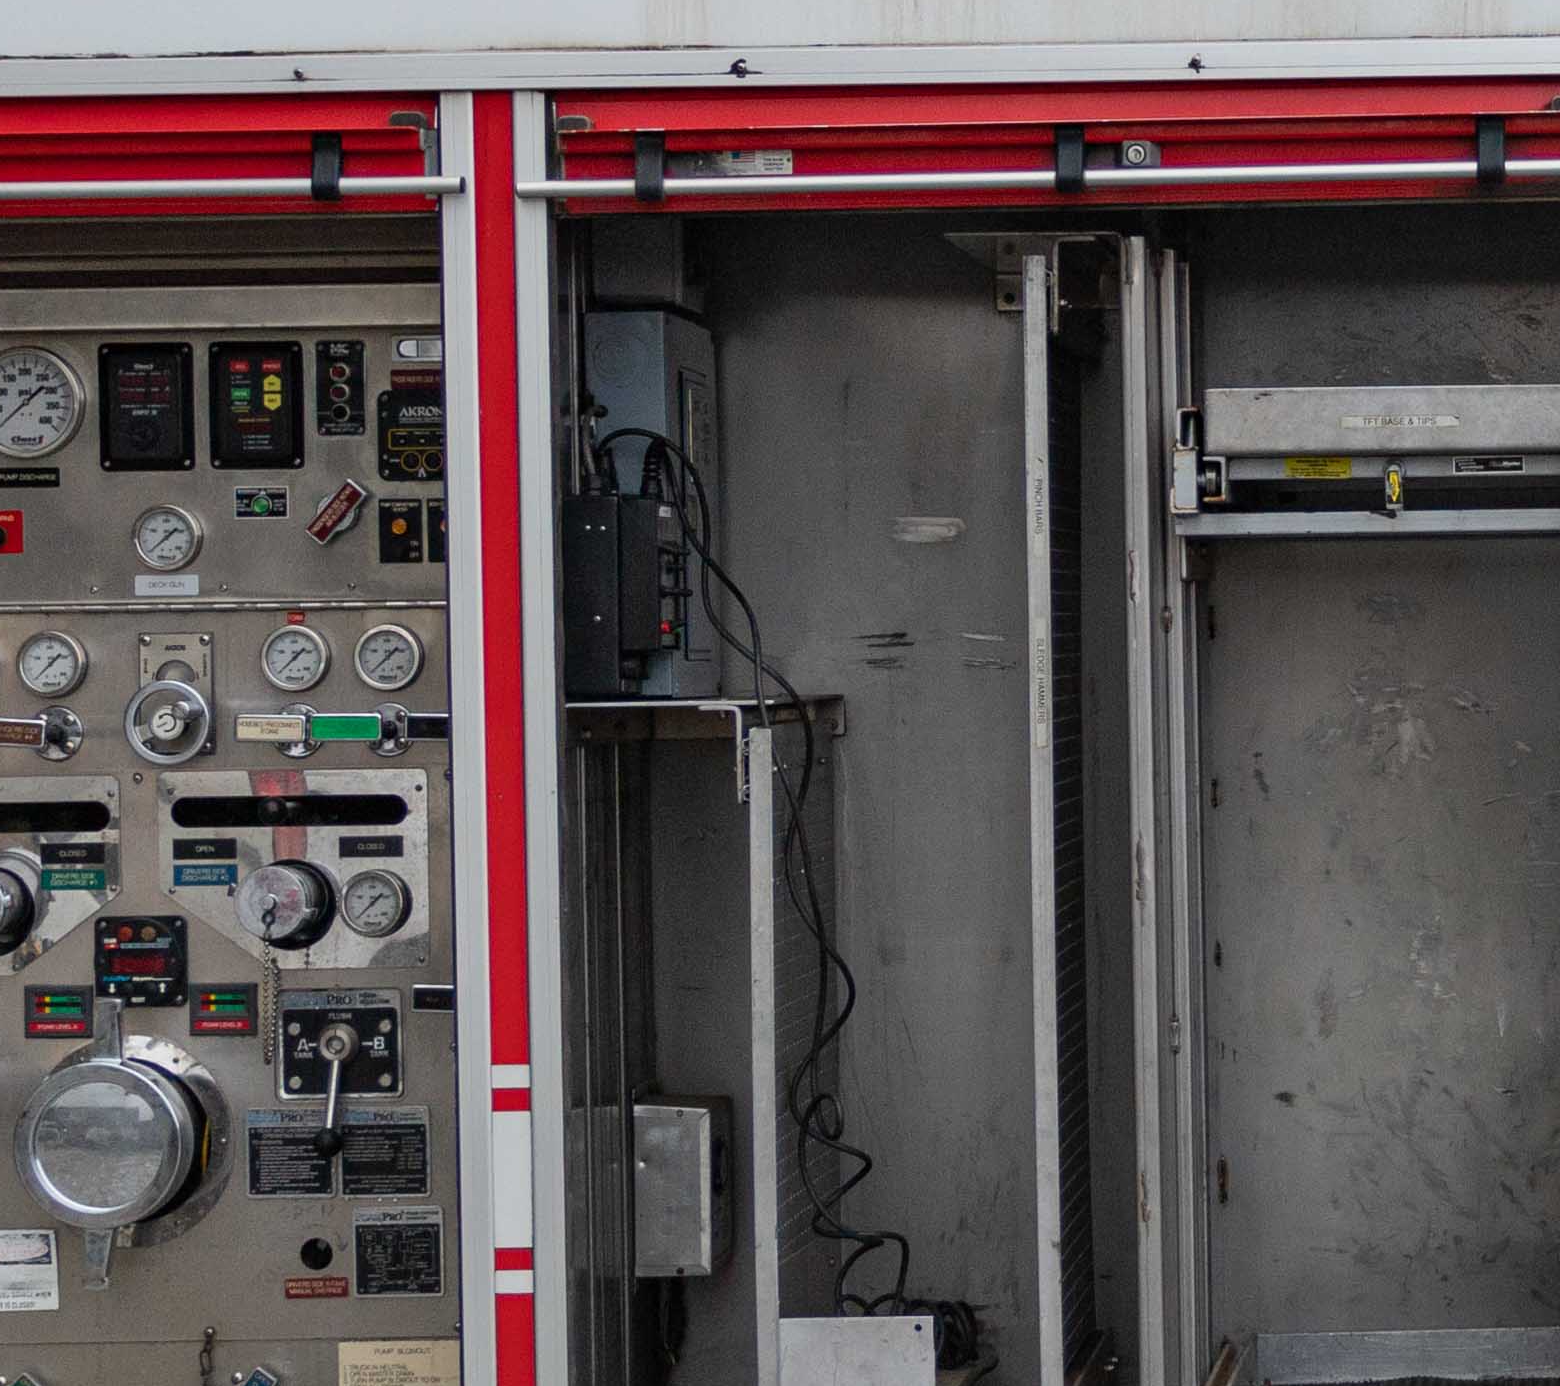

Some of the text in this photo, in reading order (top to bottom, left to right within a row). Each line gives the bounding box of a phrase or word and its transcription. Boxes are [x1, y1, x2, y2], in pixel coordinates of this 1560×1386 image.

[18, 388, 32, 398] psi
[400, 406, 443, 417] AKRON
[1362, 416, 1437, 426] TFT BASE & TIPS
[148, 581, 185, 589] DECK GUN
[1037, 677, 1046, 725] HAMMERS
[195, 844, 215, 852] OPEN
[356, 842, 385, 850] CLOSED
[58, 849, 88, 857] CLOSED
[297, 1038, 309, 1051] A
[374, 1037, 385, 1050] B
[293, 1051, 314, 1059] TANK
[370, 1050, 389, 1058] TANK
